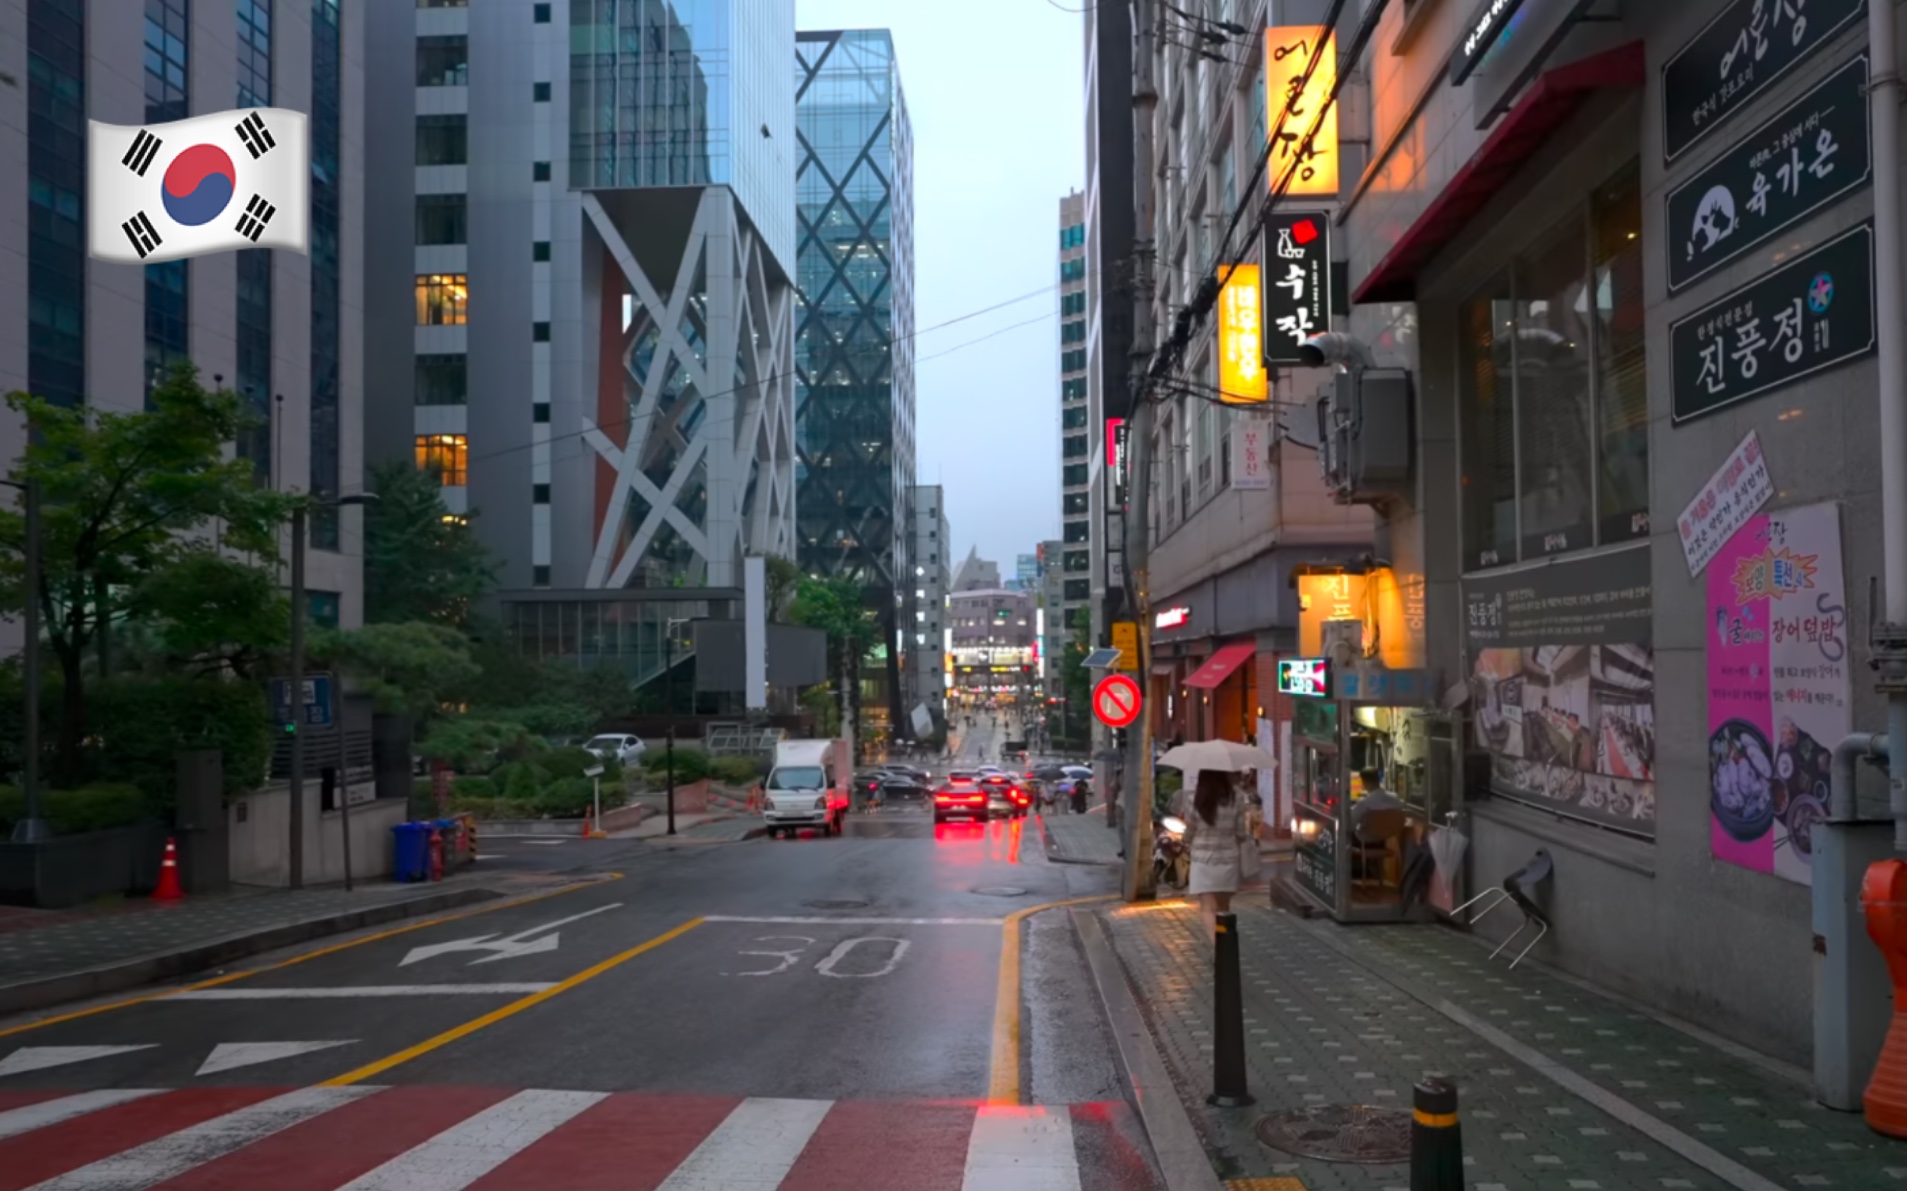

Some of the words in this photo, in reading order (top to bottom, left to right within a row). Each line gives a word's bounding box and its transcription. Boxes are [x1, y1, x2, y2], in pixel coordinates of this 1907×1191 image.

[1745, 128, 1839, 217] 육가온
[1275, 264, 1314, 346] 수작
[1696, 298, 1804, 394] 진풍정
[1244, 432, 1258, 476] 부동산
[1773, 560, 1794, 588] 특선
[718, 936, 911, 978] 30
